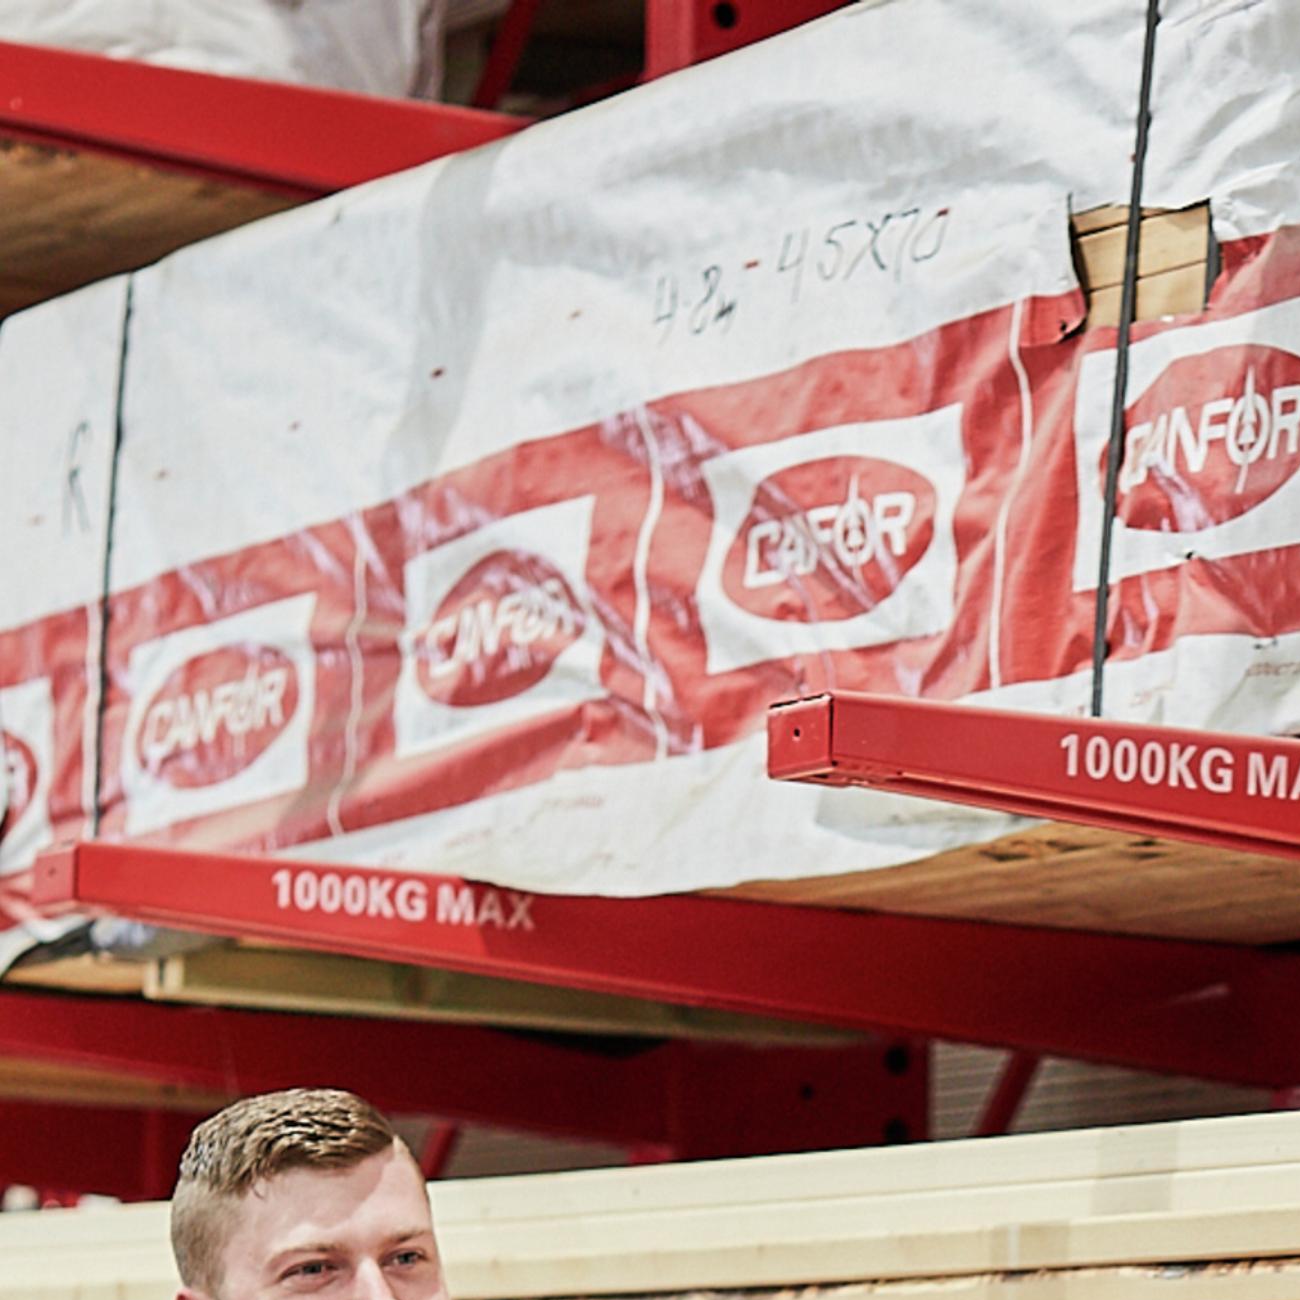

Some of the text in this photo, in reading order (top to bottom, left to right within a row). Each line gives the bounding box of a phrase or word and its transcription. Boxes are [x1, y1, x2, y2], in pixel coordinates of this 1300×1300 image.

[1060, 733, 1234, 794] 1000KG
[271, 869, 536, 932] 1000KG MAX
